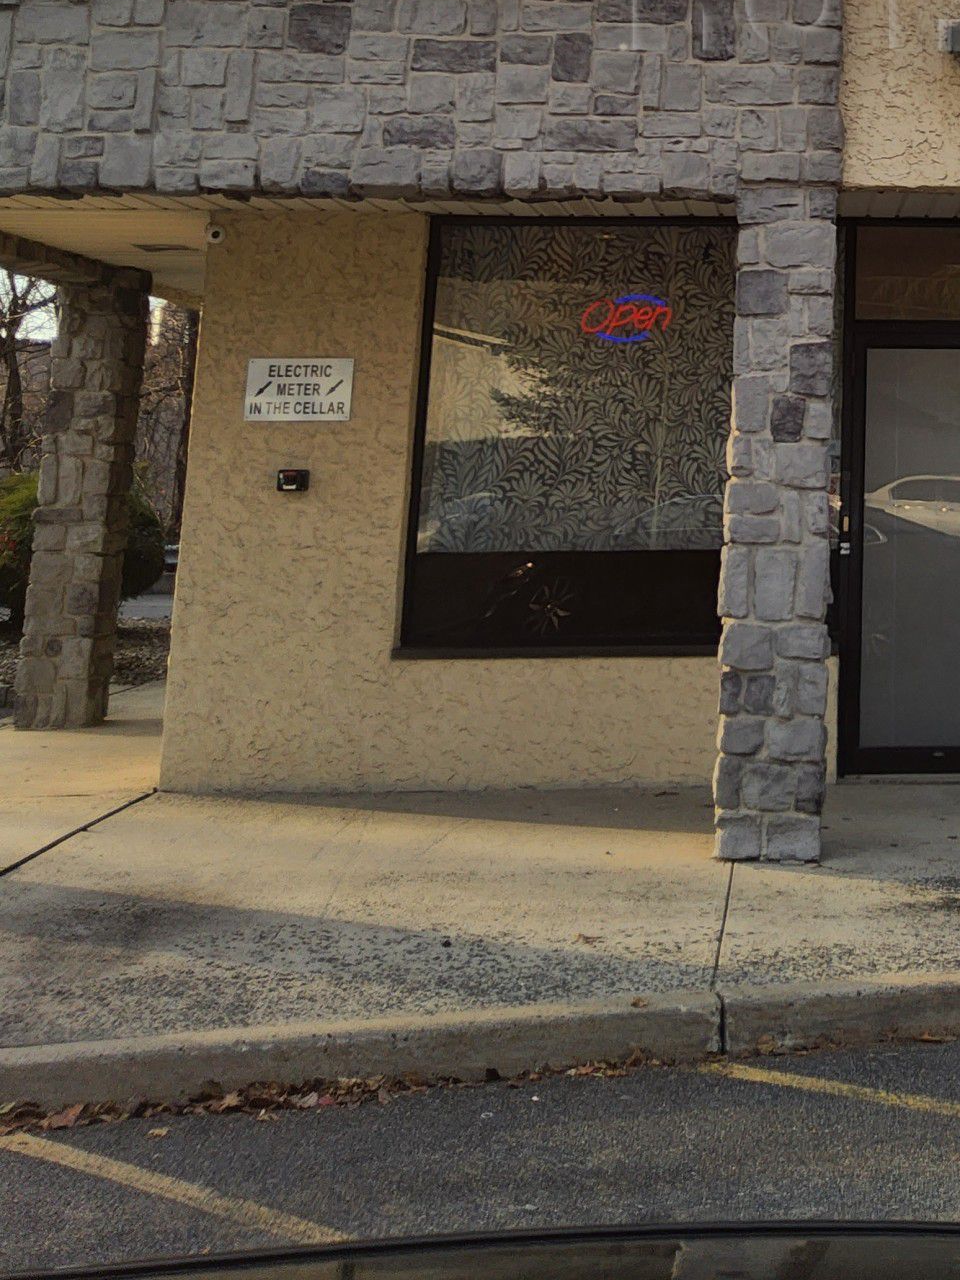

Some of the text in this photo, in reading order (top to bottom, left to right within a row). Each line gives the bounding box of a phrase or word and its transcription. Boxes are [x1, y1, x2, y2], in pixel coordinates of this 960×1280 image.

[580, 297, 672, 335] Open
[268, 364, 333, 378] ELECTRIC
[276, 383, 321, 396] METER
[249, 402, 345, 415] IN THE CELLAR
